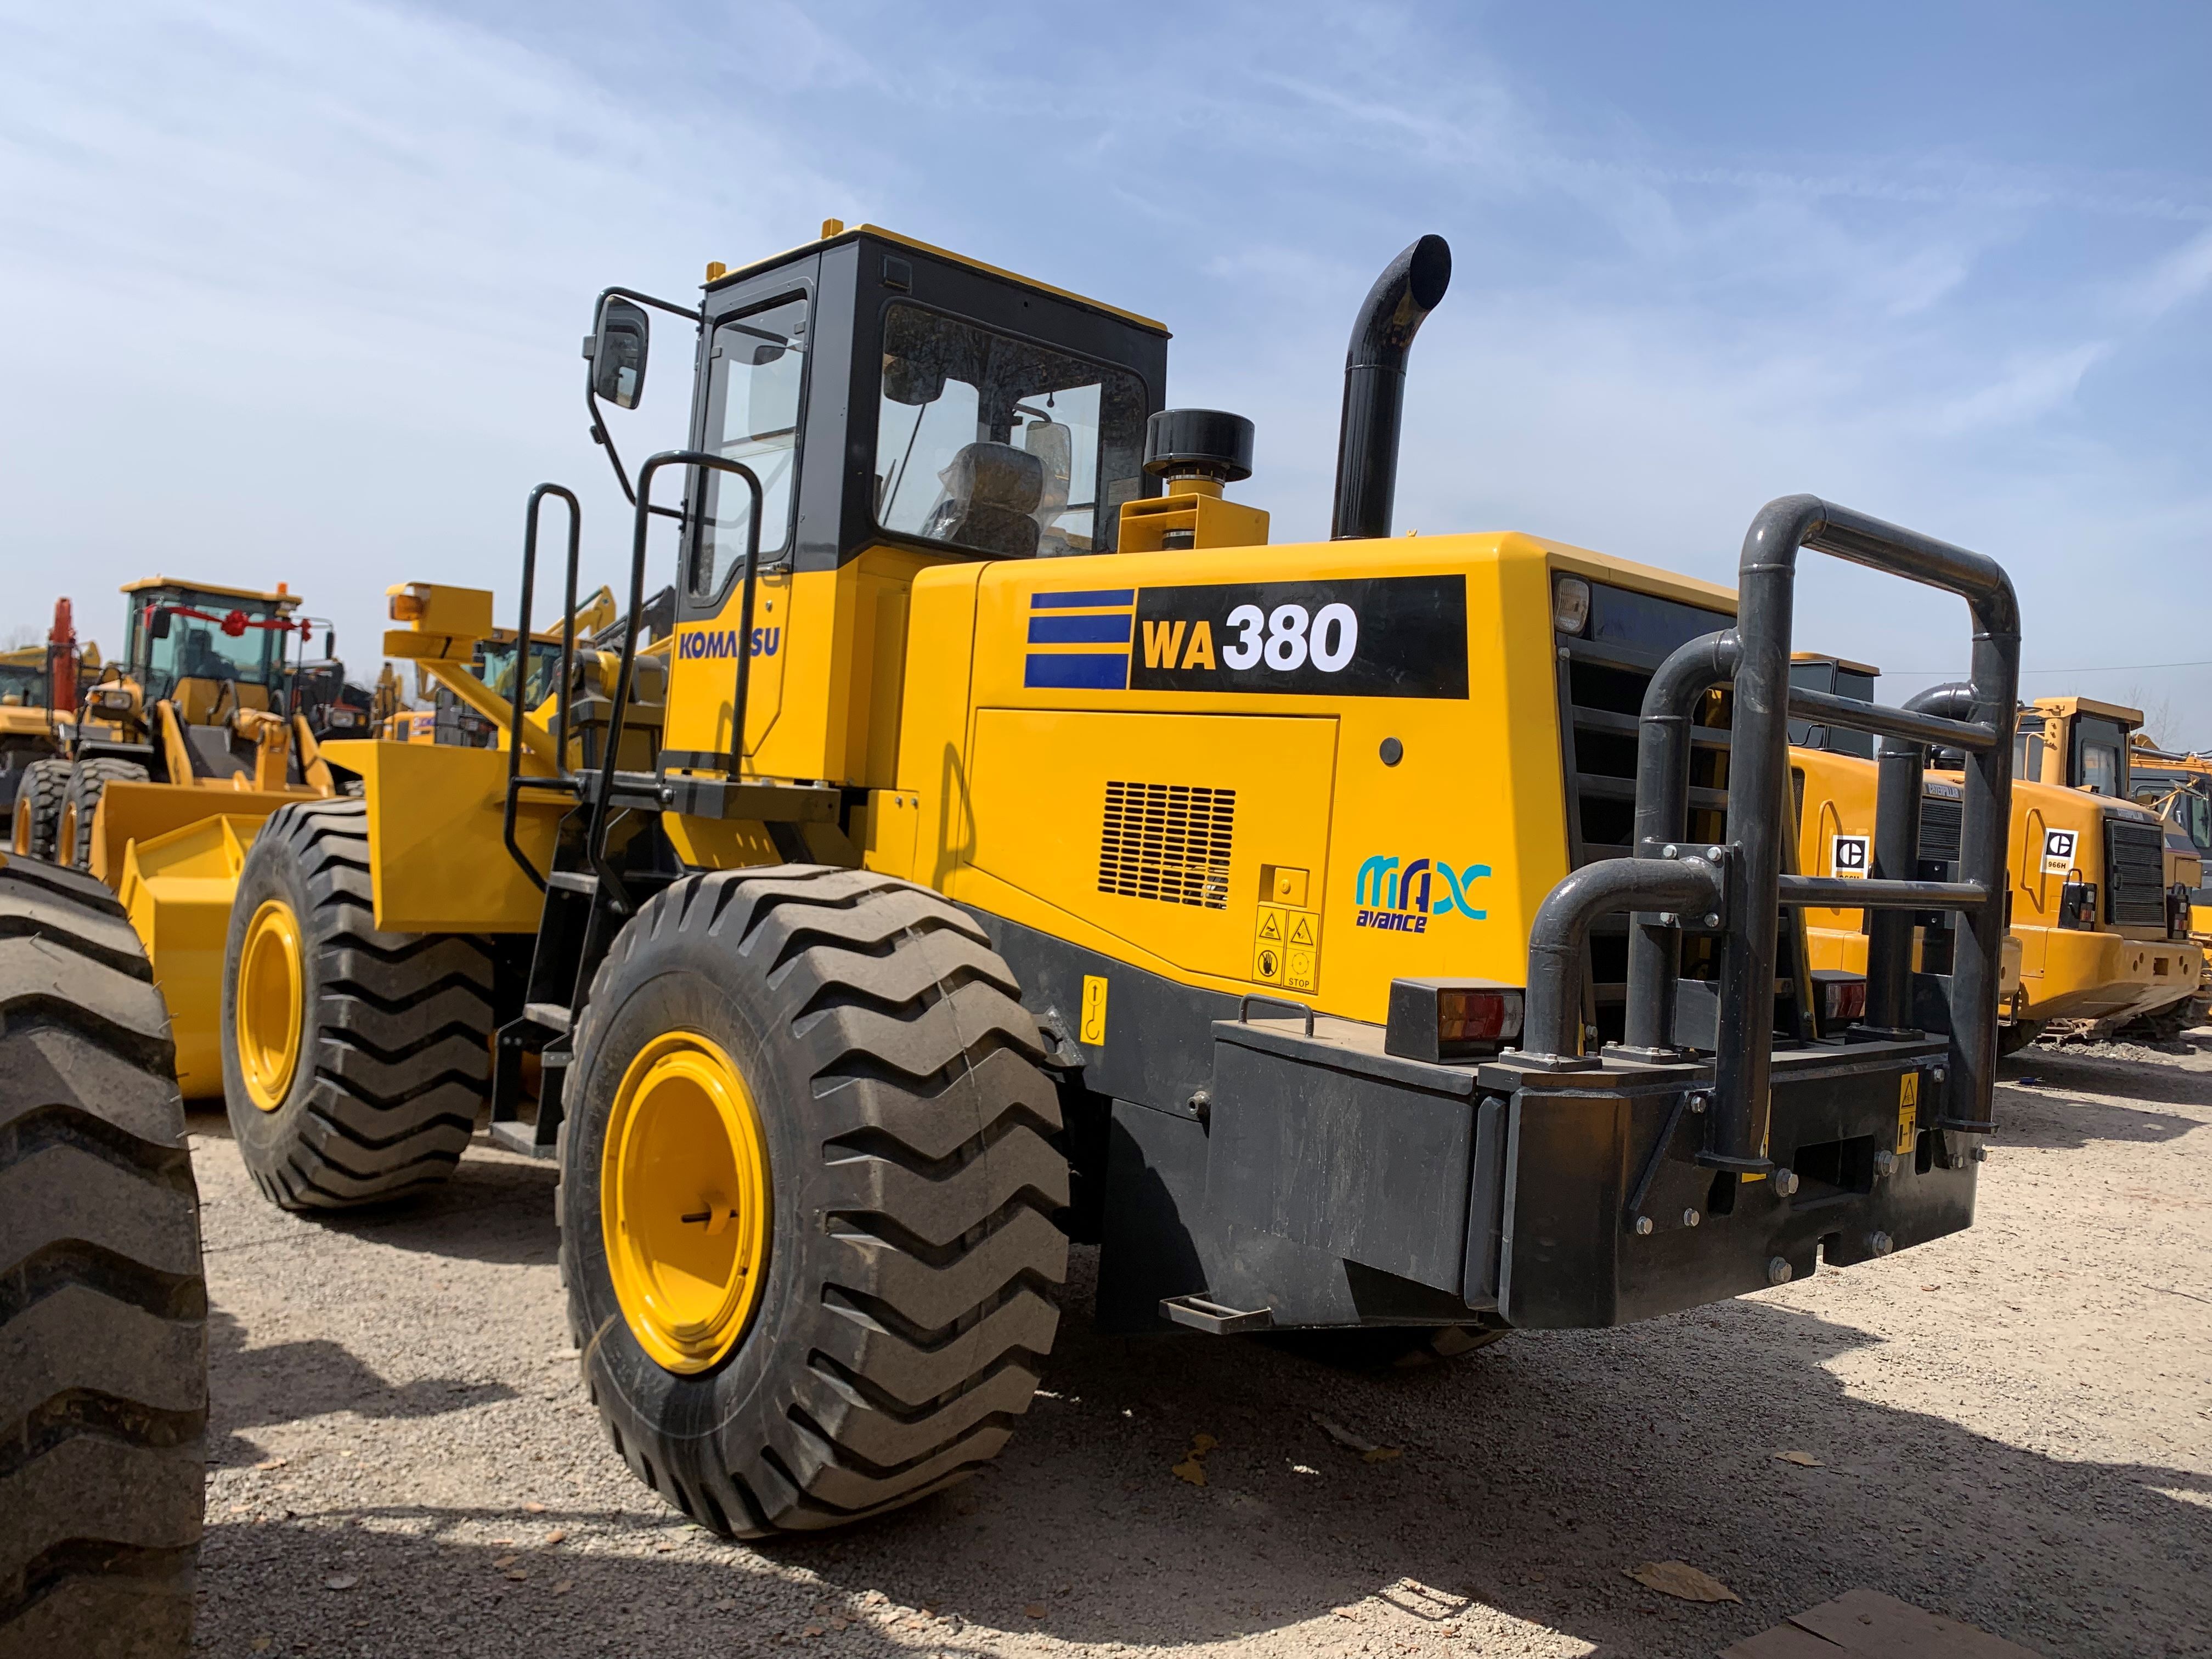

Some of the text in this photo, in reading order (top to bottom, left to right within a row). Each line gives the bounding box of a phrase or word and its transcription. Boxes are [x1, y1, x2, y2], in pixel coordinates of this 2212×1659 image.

[679, 627, 780, 659] KOMASU
[1356, 910, 1427, 934] avance
[1289, 978, 1310, 988] STOP
